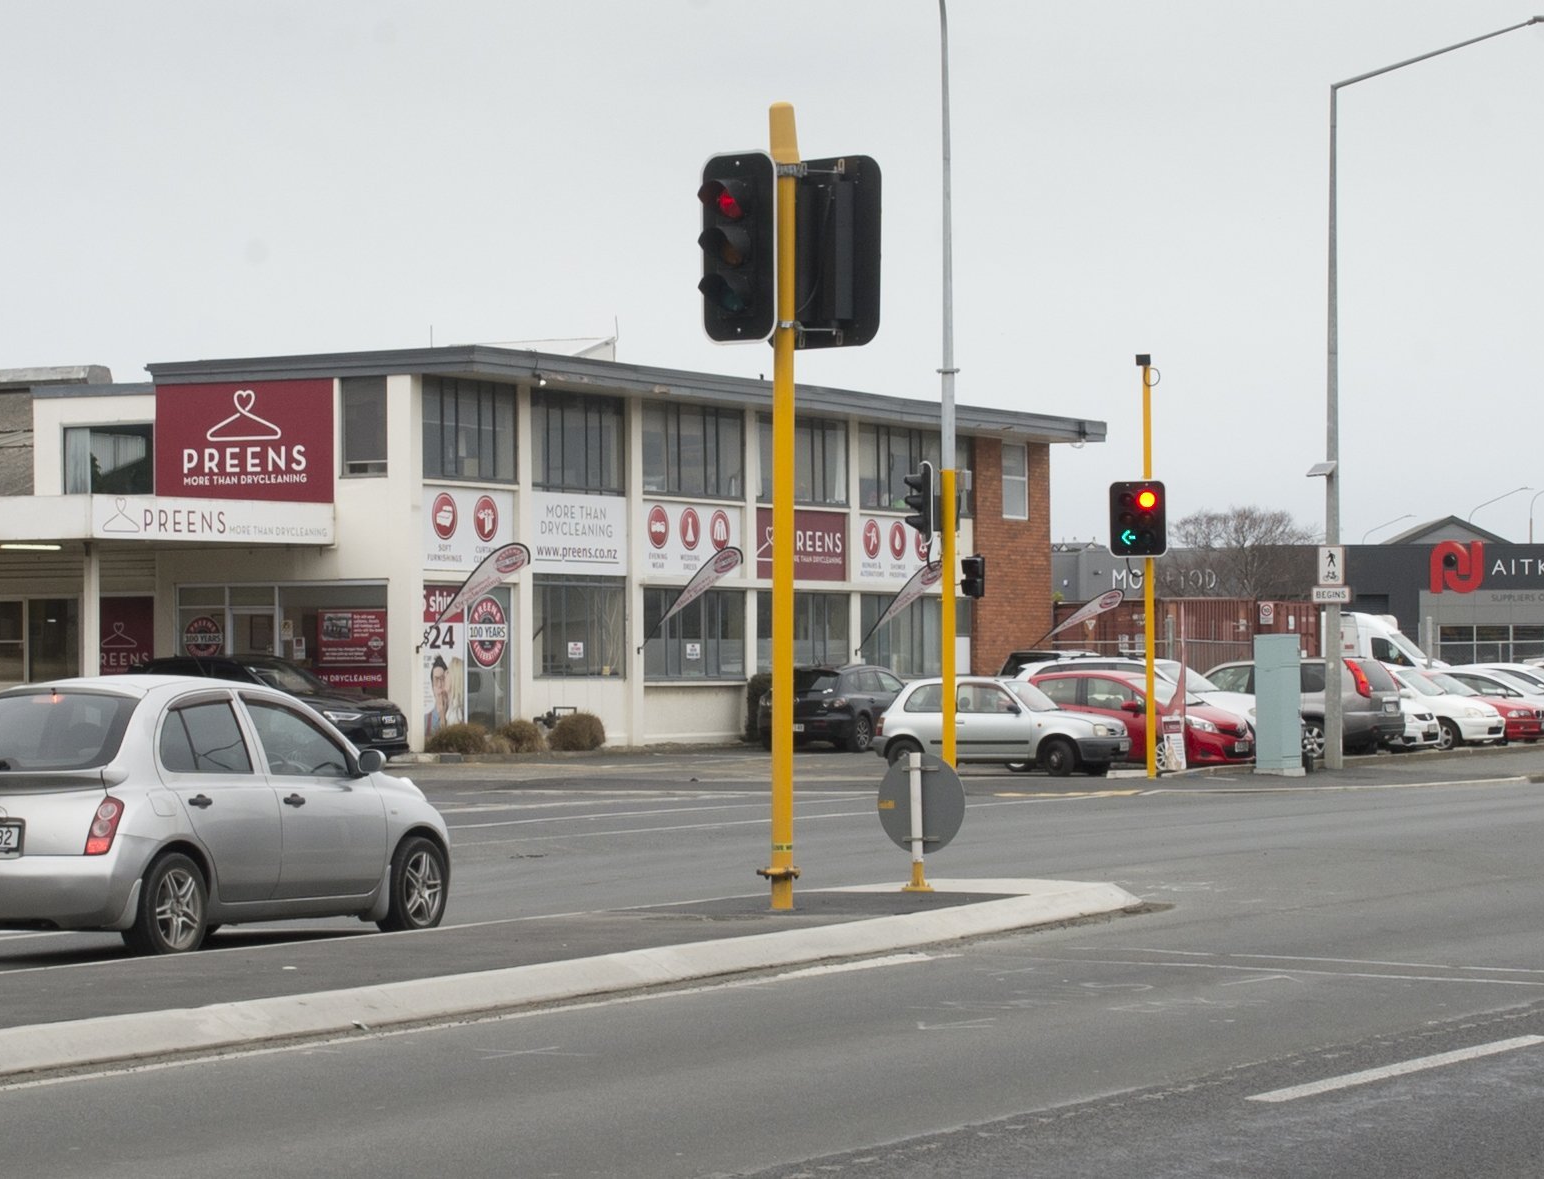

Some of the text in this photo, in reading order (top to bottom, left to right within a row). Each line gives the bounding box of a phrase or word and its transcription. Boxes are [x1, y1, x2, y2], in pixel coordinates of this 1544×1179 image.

[183, 445, 306, 474] PREENS
[183, 473, 307, 486] MORE THAN DRYCLEANING
[546, 504, 607, 520] MORE THAN
[143, 509, 327, 537] PREENS MORE THAN DRYCLEANING
[540, 521, 613, 538] DRYCLEANING
[438, 544, 452, 553] SOFT
[797, 531, 842, 553] REENS
[537, 545, 617, 559] www.preens.co.nz
[1112, 569, 1156, 589] MO
[429, 589, 456, 612] shi
[1316, 591, 1346, 599] BEGINS
[1491, 593, 1535, 602] SUPPLIERS
[474, 602, 501, 621] PREENS
[424, 625, 455, 649] $24
[470, 626, 506, 638] 100 YEARS
[100, 652, 149, 666] REENS
